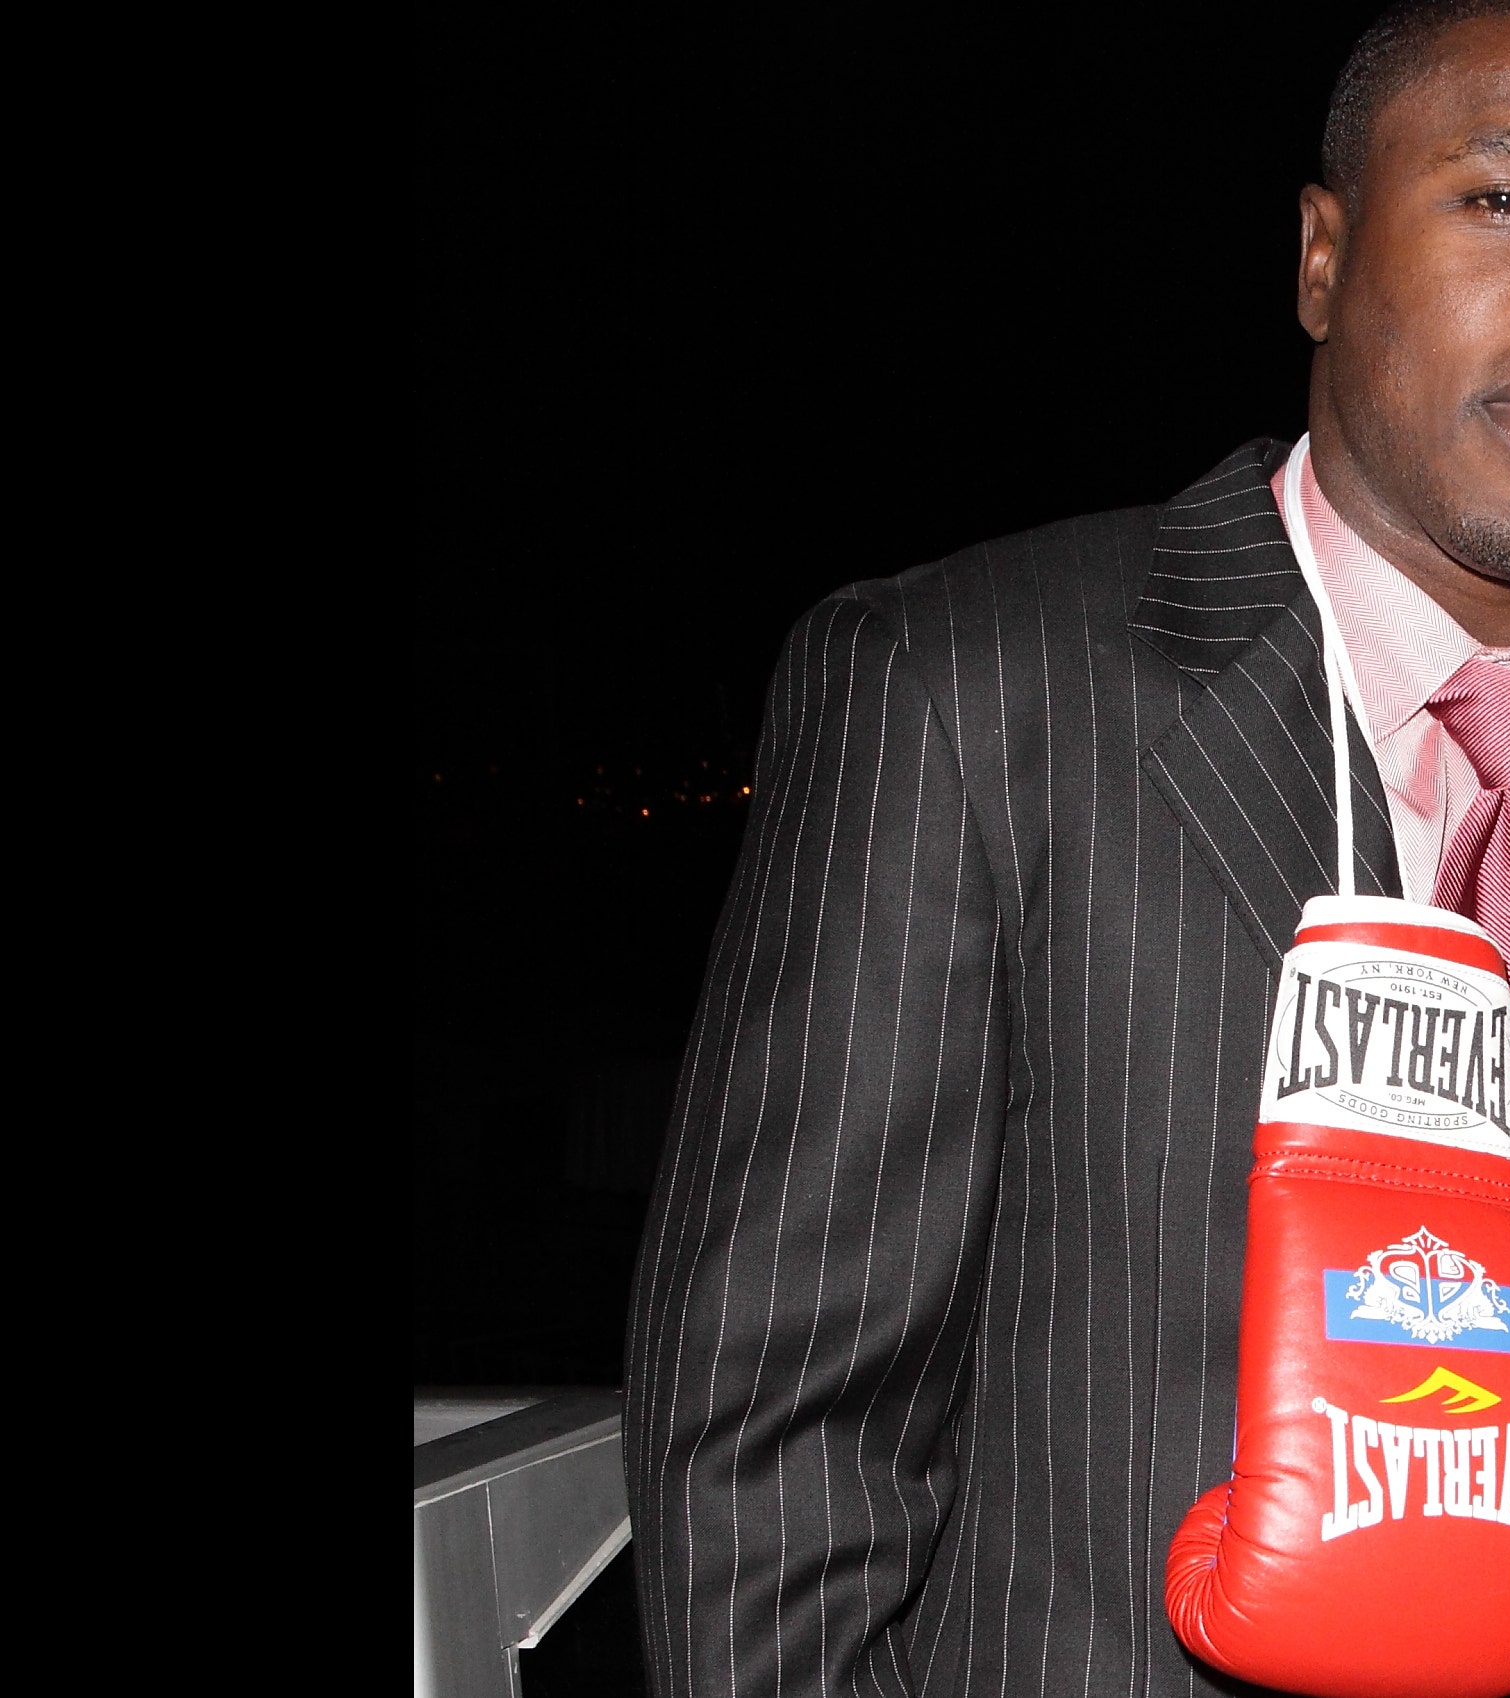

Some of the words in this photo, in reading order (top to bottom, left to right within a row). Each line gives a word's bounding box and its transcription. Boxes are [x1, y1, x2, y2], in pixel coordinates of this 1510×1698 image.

[1360, 964, 1381, 975] NY
[1390, 983, 1416, 996] 1910
[1440, 976, 1468, 995] NEW
[1420, 988, 1442, 1001] EST.
[1277, 972, 1510, 1138] EVERLAST
[1338, 1093, 1388, 1118] GOODS
[1397, 1113, 1468, 1126] SPORTING
